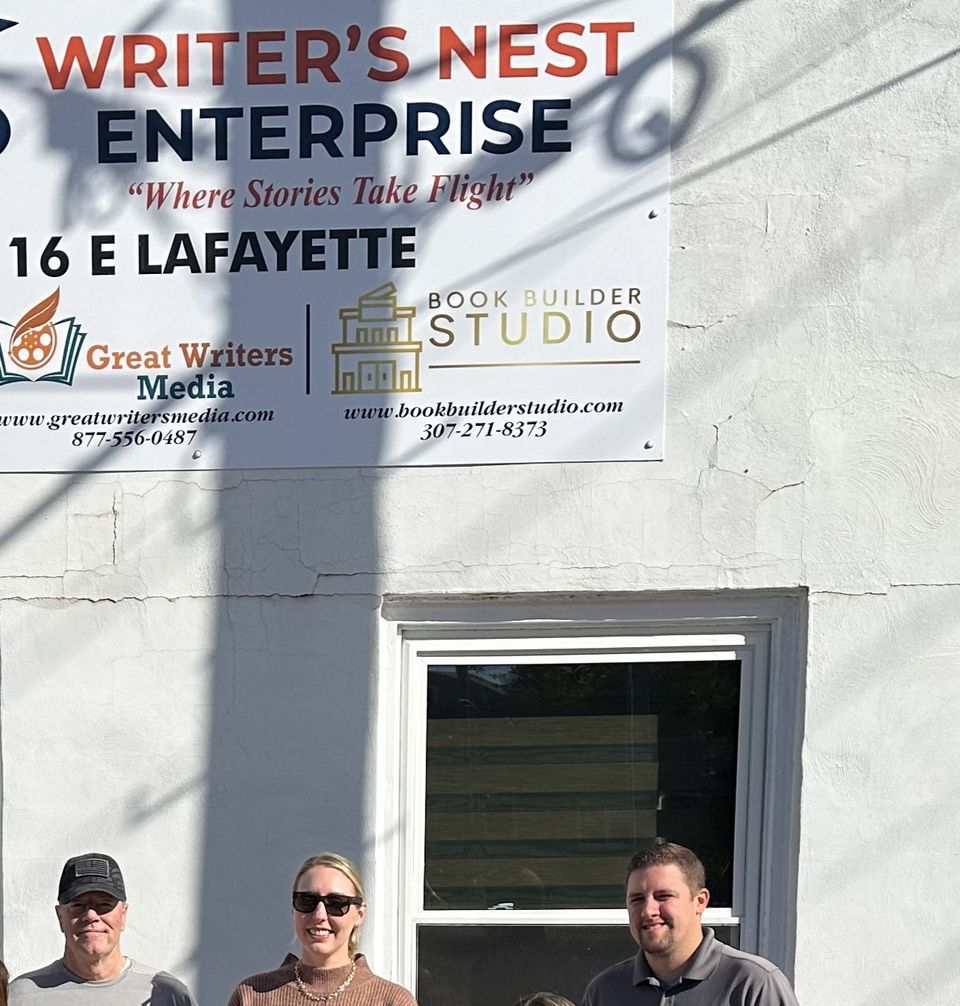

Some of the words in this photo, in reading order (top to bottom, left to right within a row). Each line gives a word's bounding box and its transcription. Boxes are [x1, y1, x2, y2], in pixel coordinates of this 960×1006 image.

[439, 21, 636, 80] NEST
[97, 98, 572, 164] ENTERPRISE
[243, 176, 341, 209] Stories
[352, 174, 419, 206] Take
[91, 235, 116, 275] E
[138, 227, 417, 275] LAFAYETTE
[428, 290, 508, 309] BOOK
[524, 287, 641, 307] BUILDER
[428, 309, 641, 348] STUDIO
[86, 344, 171, 370] Great
[179, 341, 294, 368] Writers
[137, 373, 235, 400] Media
[343, 398, 624, 420] www.bookbuilderstudio.com
[72, 429, 197, 447] 877-556-0487
[420, 421, 548, 441] 307-271-8373
